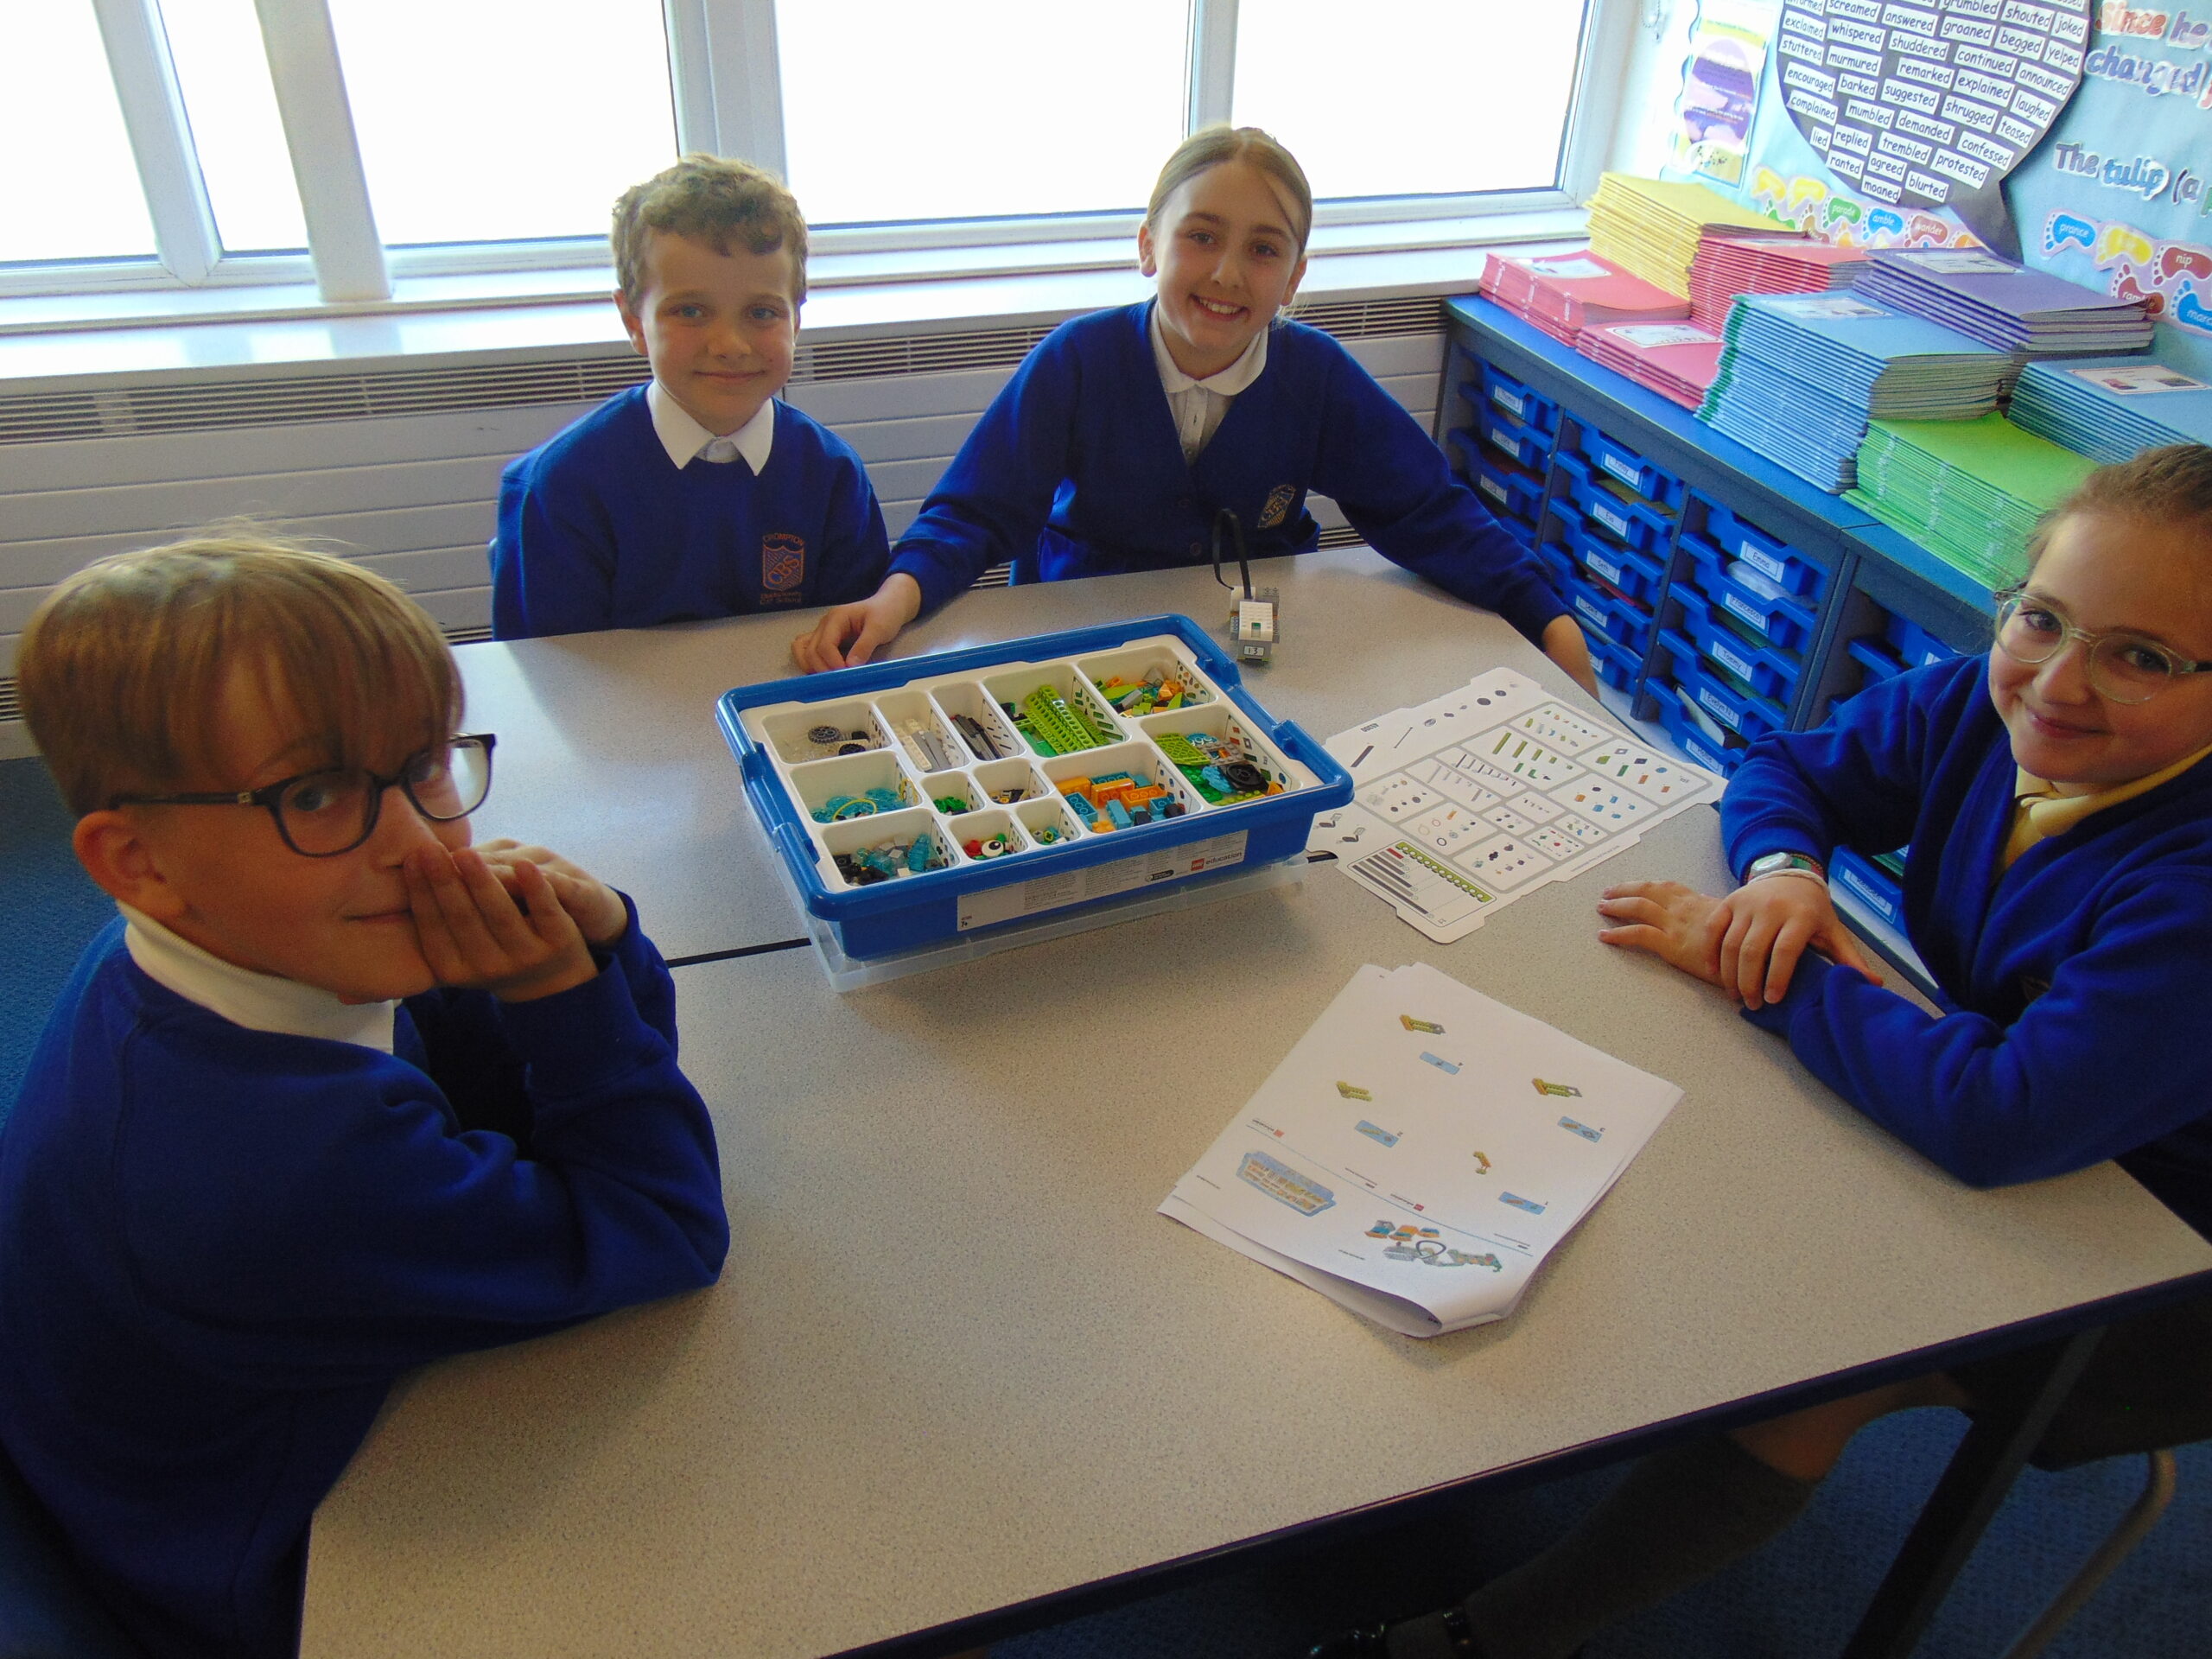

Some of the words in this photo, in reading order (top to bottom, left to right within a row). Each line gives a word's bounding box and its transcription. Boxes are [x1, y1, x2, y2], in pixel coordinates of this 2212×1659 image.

[1829, 0, 1878, 17] screamed
[2005, 7, 2051, 28] shouted
[1785, 16, 1824, 38] exclaimed
[1885, 13, 1934, 32] answered
[1944, 22, 1992, 40] groaned
[2055, 16, 2083, 37] joked
[1832, 23, 1882, 45] whispered
[2000, 30, 2041, 54] begged
[1783, 39, 1822, 61] stuttered
[1891, 35, 1948, 58] shuddered
[1829, 52, 1878, 73] murmured
[1958, 50, 2013, 73] continued
[2049, 47, 2079, 68] yelped
[1788, 68, 1834, 92] encouraged
[1901, 63, 1952, 84] remarked
[2019, 68, 2071, 96] announced
[1840, 76, 1876, 96] barked
[1885, 86, 1936, 107] suggested
[1958, 77, 2011, 100] explained
[1791, 97, 1836, 120] complained
[1849, 104, 1892, 125] mumbled
[1945, 101, 1994, 126] shrugged
[2016, 95, 2050, 121] laughed
[1812, 129, 1828, 146] lied
[1899, 116, 1951, 141] demanded
[2002, 120, 2031, 143] teased
[1835, 130, 1869, 149] replied
[1883, 137, 1930, 162] trembled
[1961, 138, 2010, 167] confessed
[1830, 156, 1861, 175] ranted
[1871, 157, 1904, 176] agreed
[1936, 154, 1987, 181] protested
[2055, 143, 2100, 175] The
[2103, 156, 2165, 197] tulip
[1864, 181, 1900, 201] moaned
[1909, 176, 1946, 199] blurted
[1872, 214, 1896, 226] amble
[1914, 222, 1943, 236] wander
[2175, 253, 2193, 269] nip
[1205, 851, 1243, 865] education
